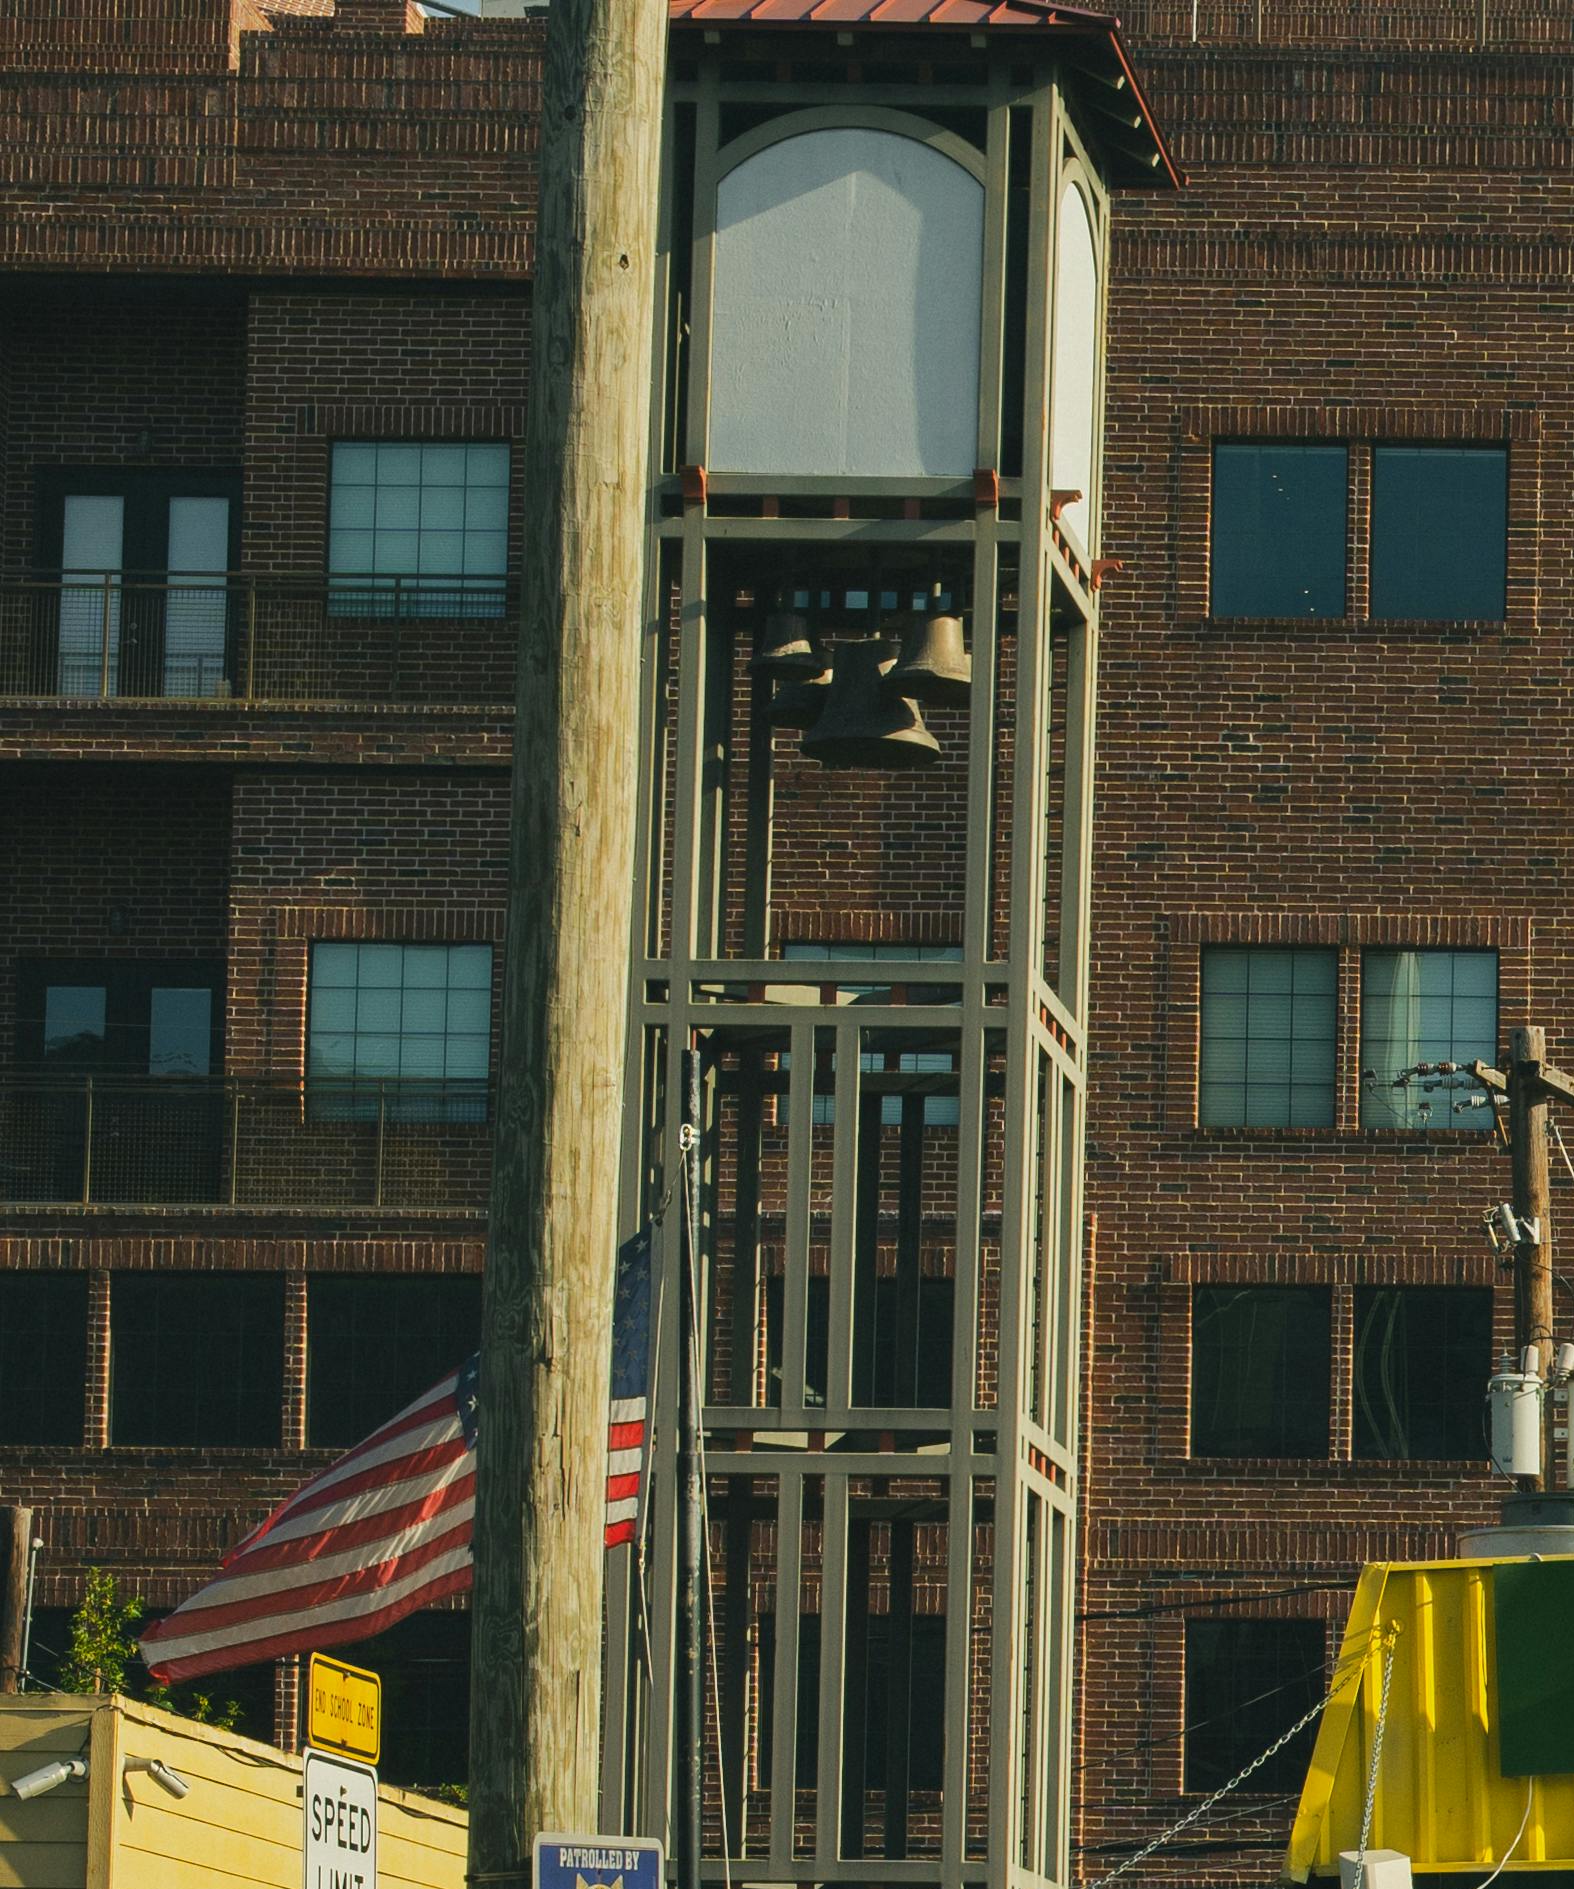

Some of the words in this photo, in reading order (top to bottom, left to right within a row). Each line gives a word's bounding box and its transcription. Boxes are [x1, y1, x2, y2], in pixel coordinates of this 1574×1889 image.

[315, 1688, 326, 1714] END
[330, 1694, 353, 1724] SCHOOL
[357, 1702, 374, 1730] ZONE
[311, 1793, 371, 1854] SPEED
[560, 1847, 623, 1870] PATROLLED
[625, 1851, 640, 1871] BY
